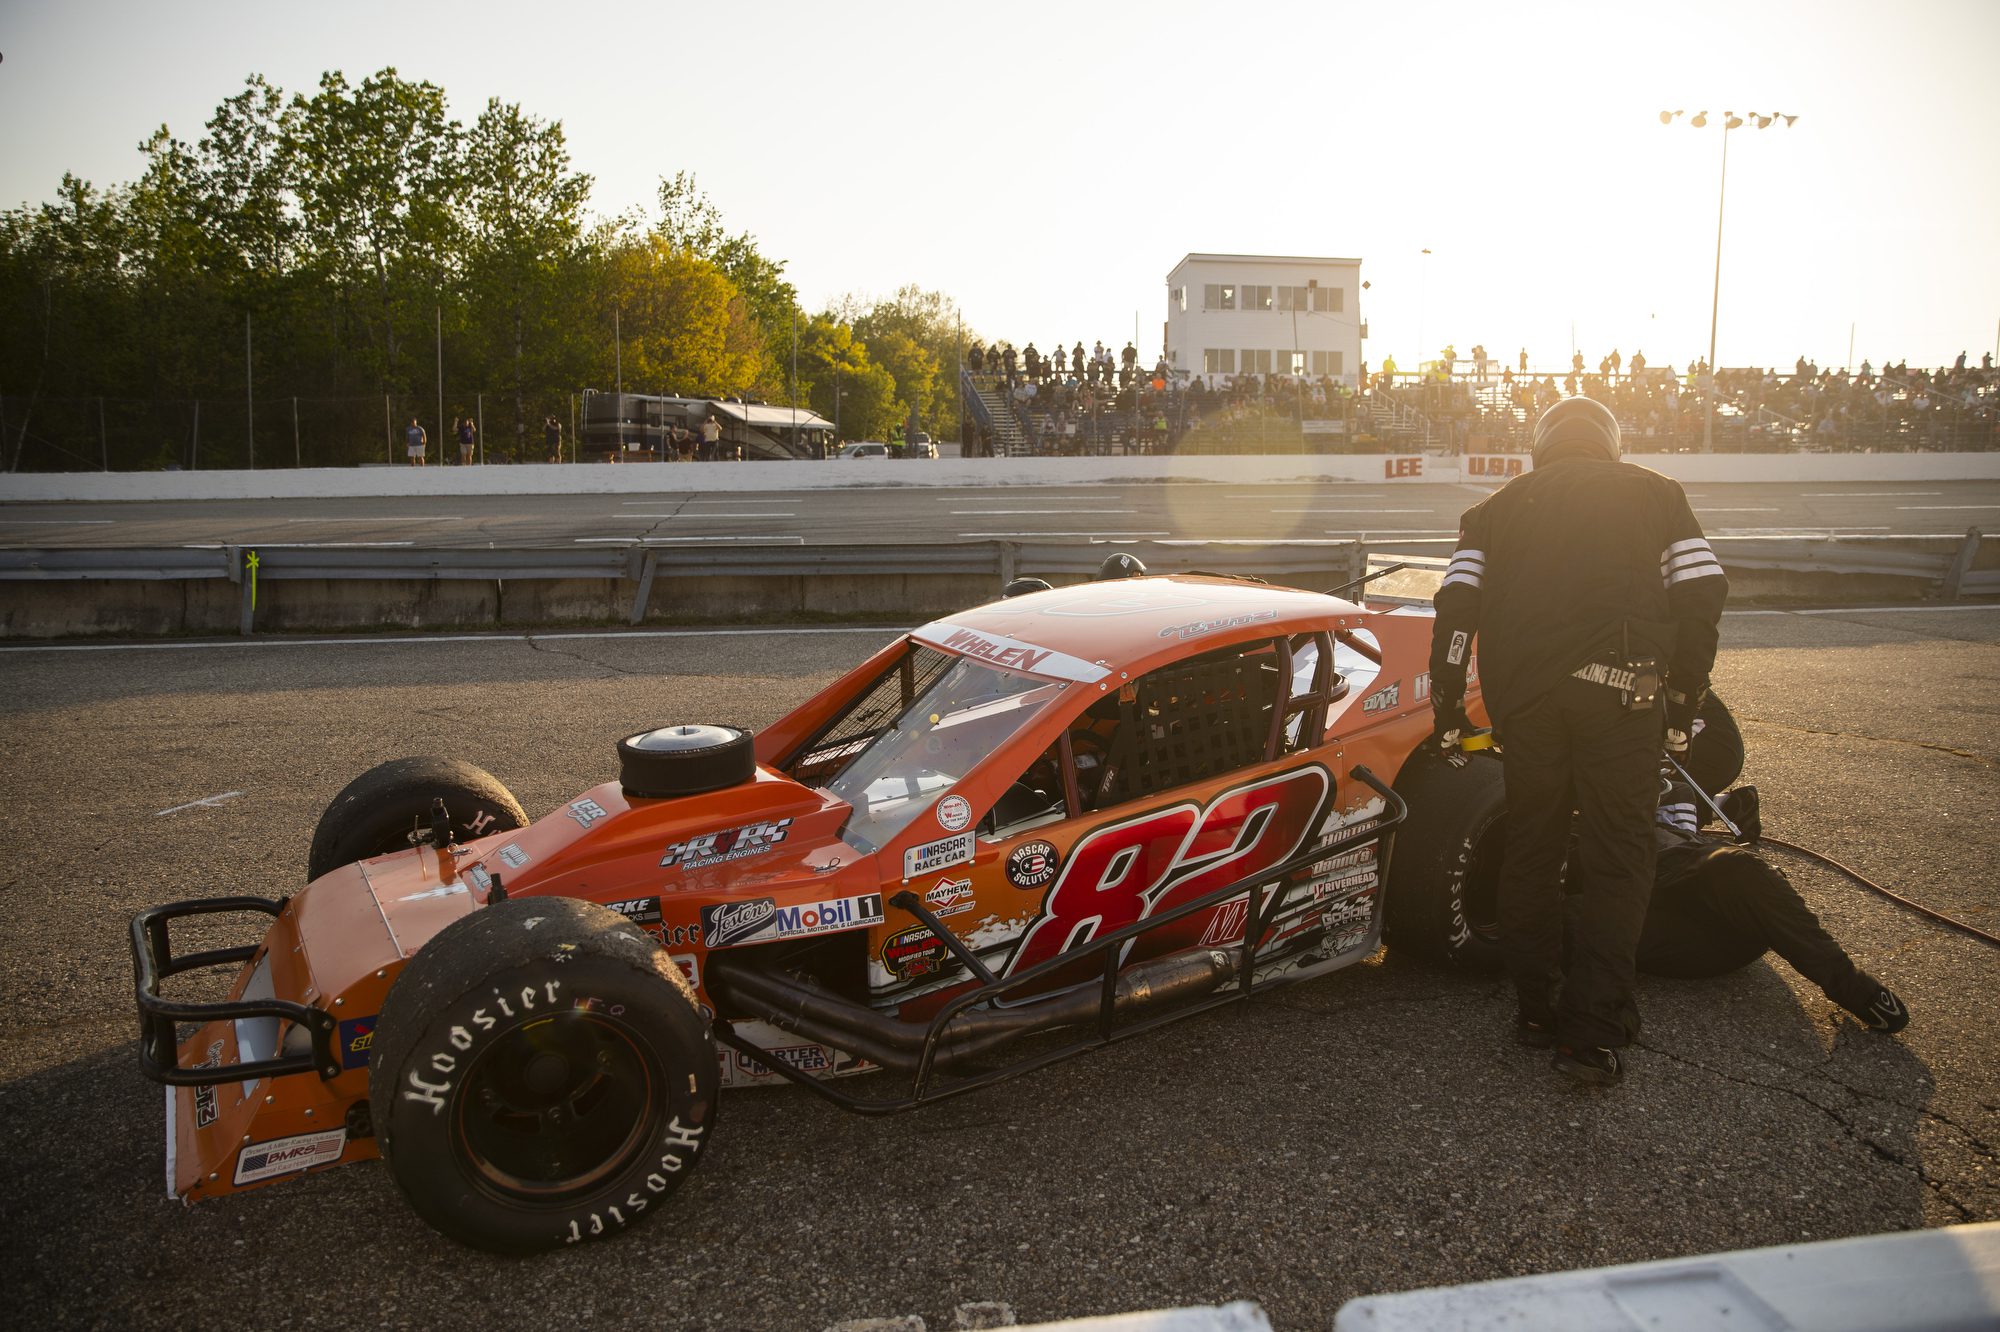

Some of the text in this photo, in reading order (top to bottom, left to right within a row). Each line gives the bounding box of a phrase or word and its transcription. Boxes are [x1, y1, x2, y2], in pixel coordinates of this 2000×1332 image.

[1385, 456, 1523, 479] LEE USA
[942, 628, 1054, 672] WHELEN
[1607, 667, 1636, 691] ELEC
[682, 844, 772, 871] RACING ENGINES
[926, 836, 967, 858] NASCAR
[1012, 844, 1050, 863] NASCAR
[914, 849, 966, 872] RACE CAR
[996, 764, 1330, 1008] 82
[1013, 866, 1054, 885] SALUTES
[1324, 871, 1376, 893] RIVERHEAD
[926, 883, 970, 901] MAYHEW
[1446, 837, 1472, 948] Hoosier
[705, 901, 775, 948] Jostens
[777, 897, 875, 932] Mobil 1
[1321, 901, 1374, 927] GOODIE
[641, 920, 701, 947] sier
[780, 928, 806, 938] OFFICIAL
[807, 924, 829, 934] MOTOR
[847, 916, 884, 928] LUBRICANTS
[903, 928, 935, 944] NASCAR
[886, 937, 944, 959] WHELEN
[898, 948, 936, 963] MODIFIED TOUR
[403, 980, 561, 1116] Hoosier
[738, 1046, 821, 1068] QRTER
[753, 1057, 826, 1074] MTER
[267, 1144, 316, 1164] BMRS
[556, 1116, 704, 1244] Hoosier
